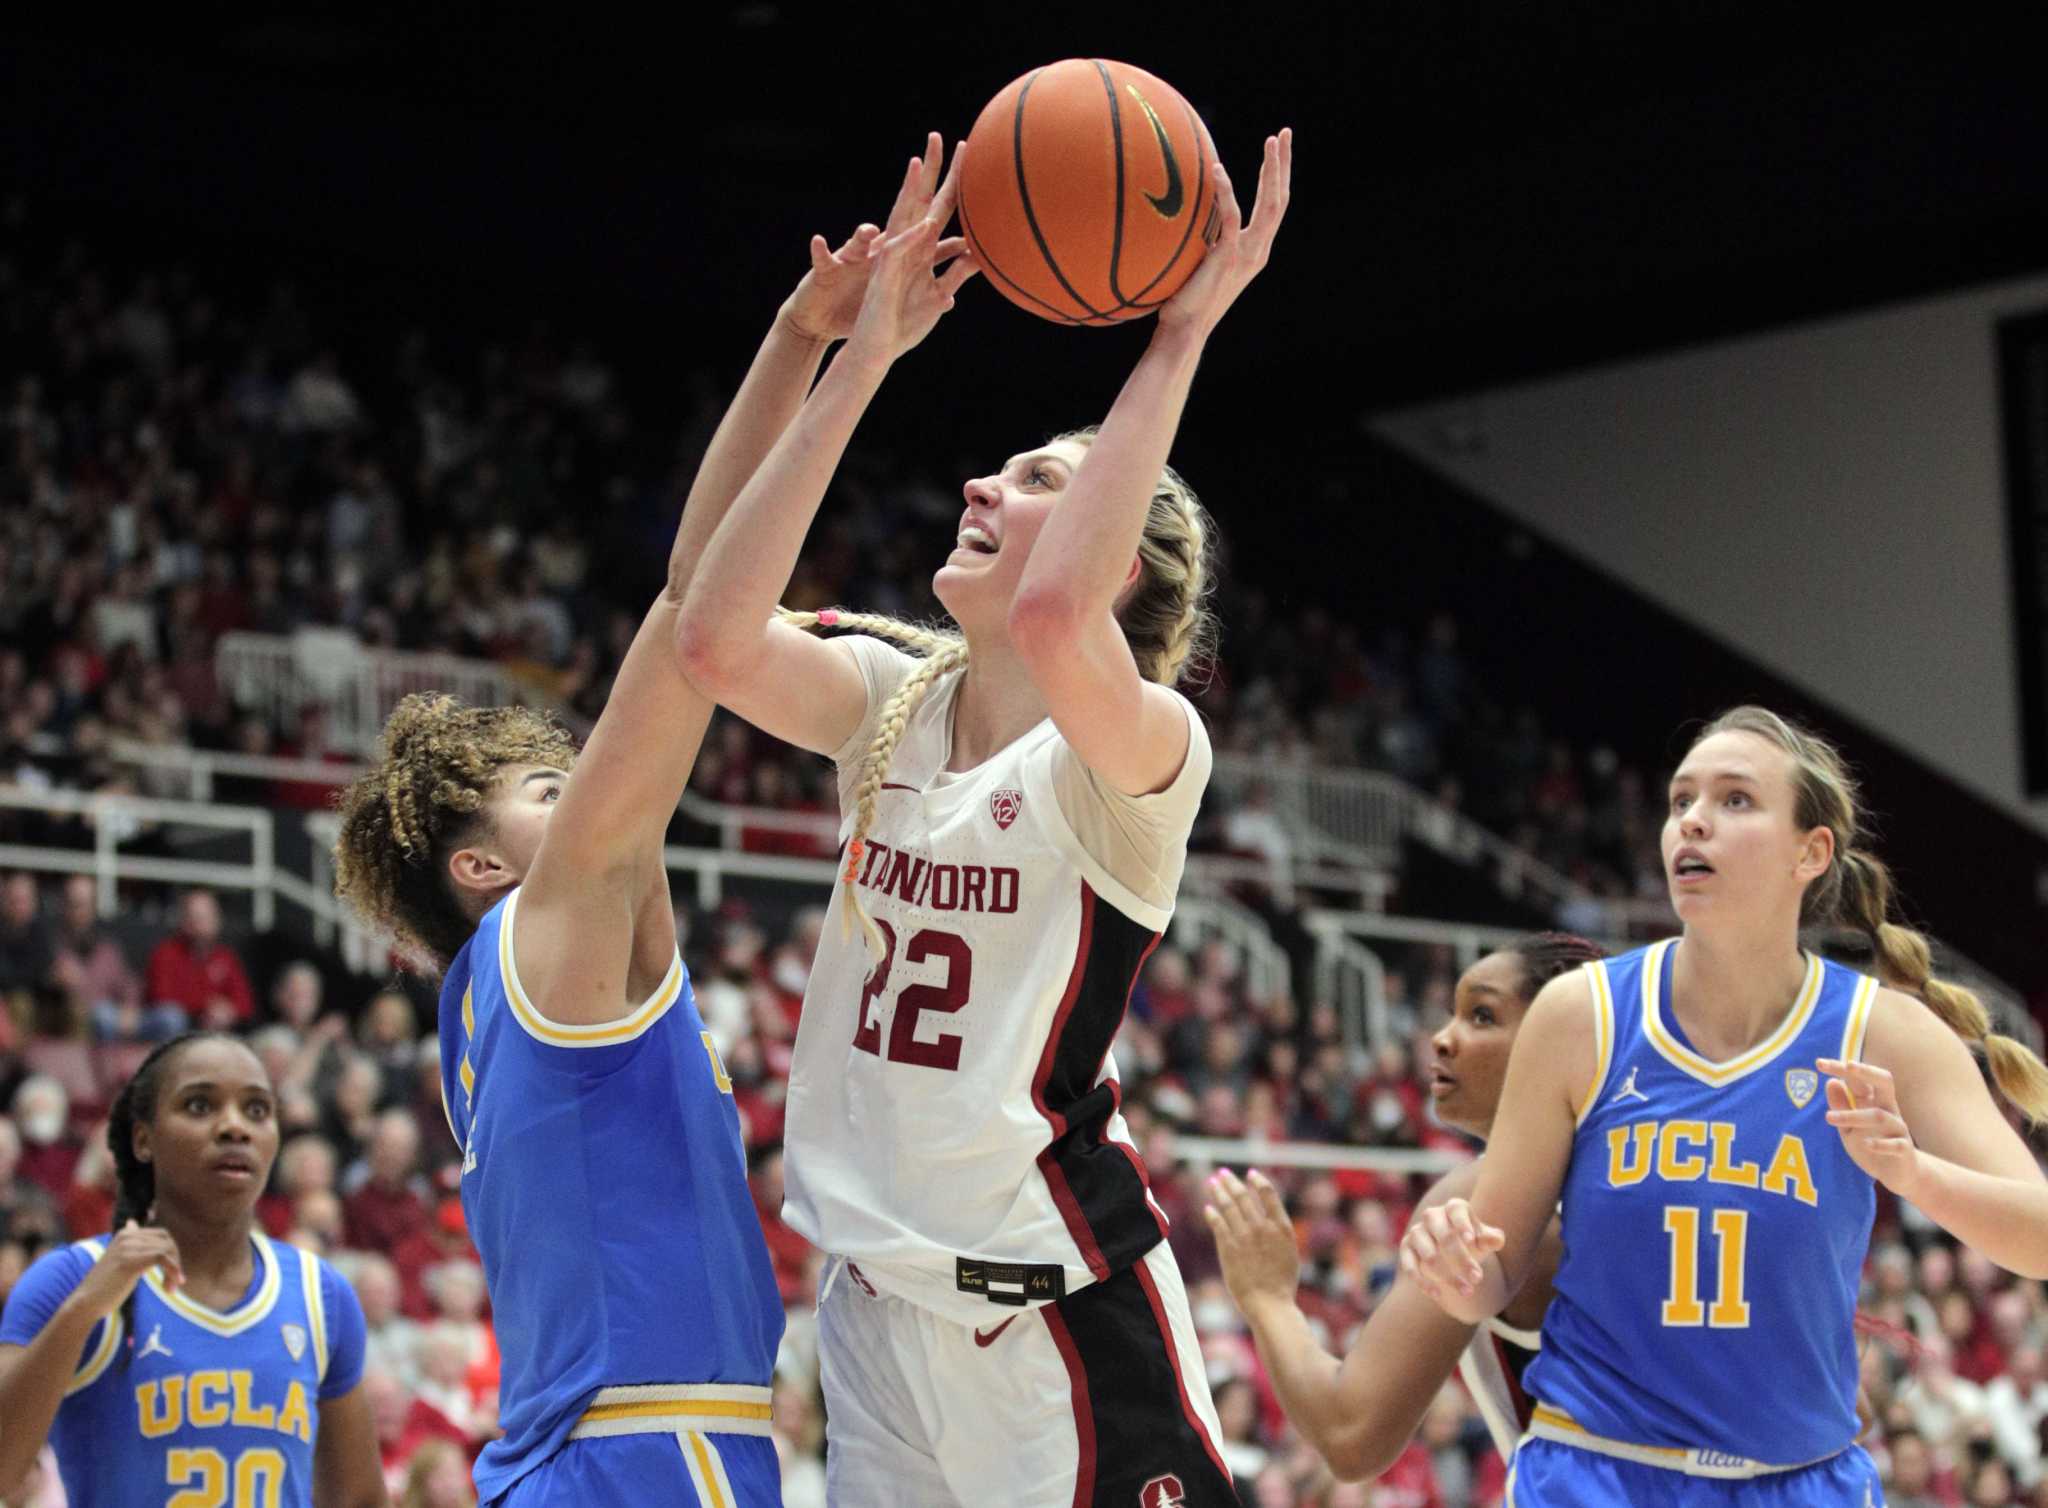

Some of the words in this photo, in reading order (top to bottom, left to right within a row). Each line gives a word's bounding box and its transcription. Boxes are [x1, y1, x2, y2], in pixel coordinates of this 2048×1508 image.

[993, 807, 1013, 822] 12
[839, 835, 1020, 914] TANORD
[852, 917, 972, 1072] 22
[1606, 1120, 1818, 1208] UCLA
[1661, 1206, 1750, 1329] 11
[135, 1369, 311, 1444] UCLA
[165, 1447, 286, 1508] 20
